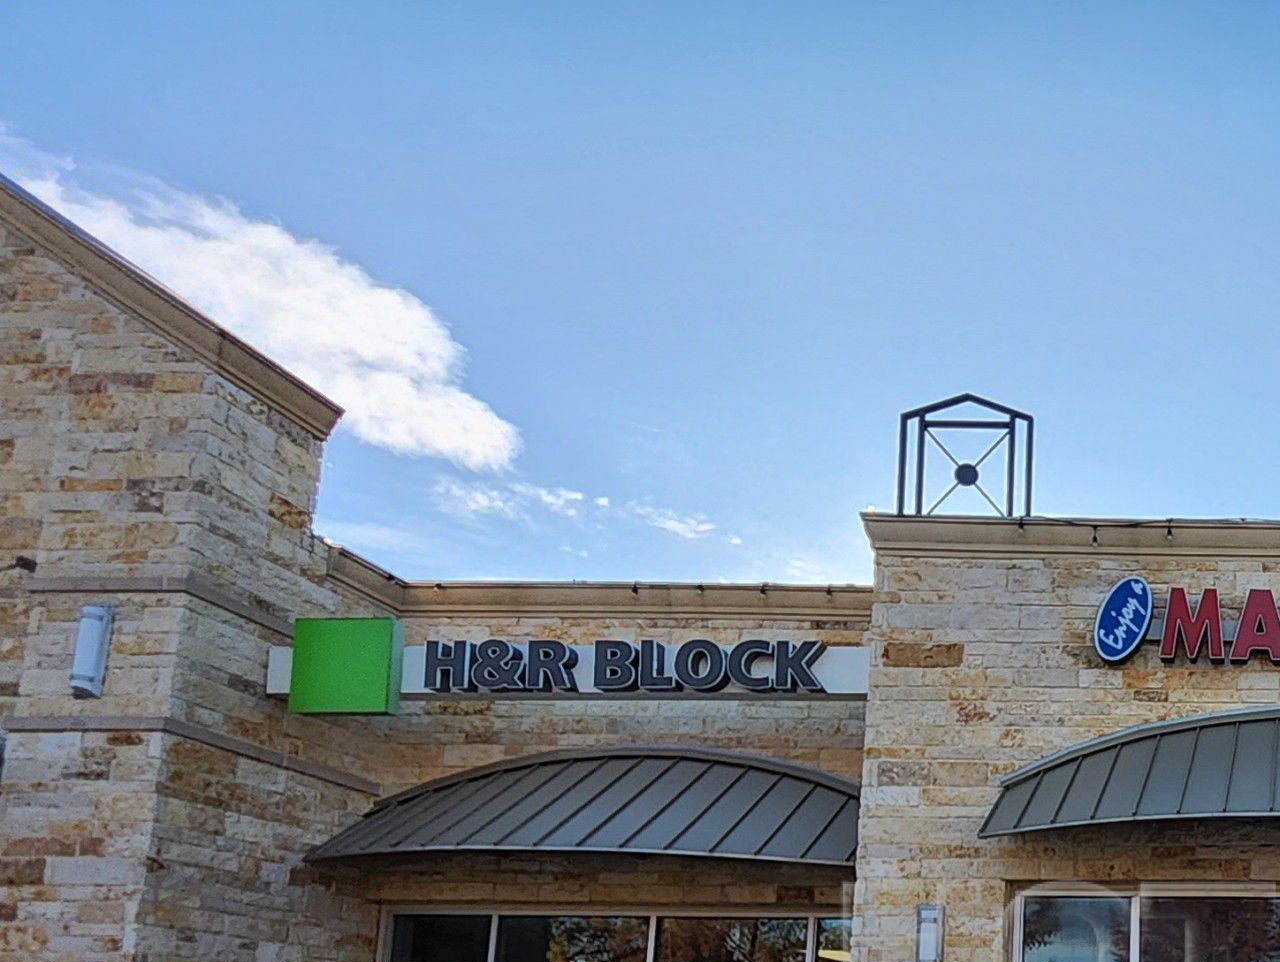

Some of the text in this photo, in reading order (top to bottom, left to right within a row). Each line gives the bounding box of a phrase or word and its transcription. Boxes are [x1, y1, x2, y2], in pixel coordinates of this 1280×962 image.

[1099, 597, 1147, 650] Enjoy
[423, 639, 828, 693] H&R BLOCK
